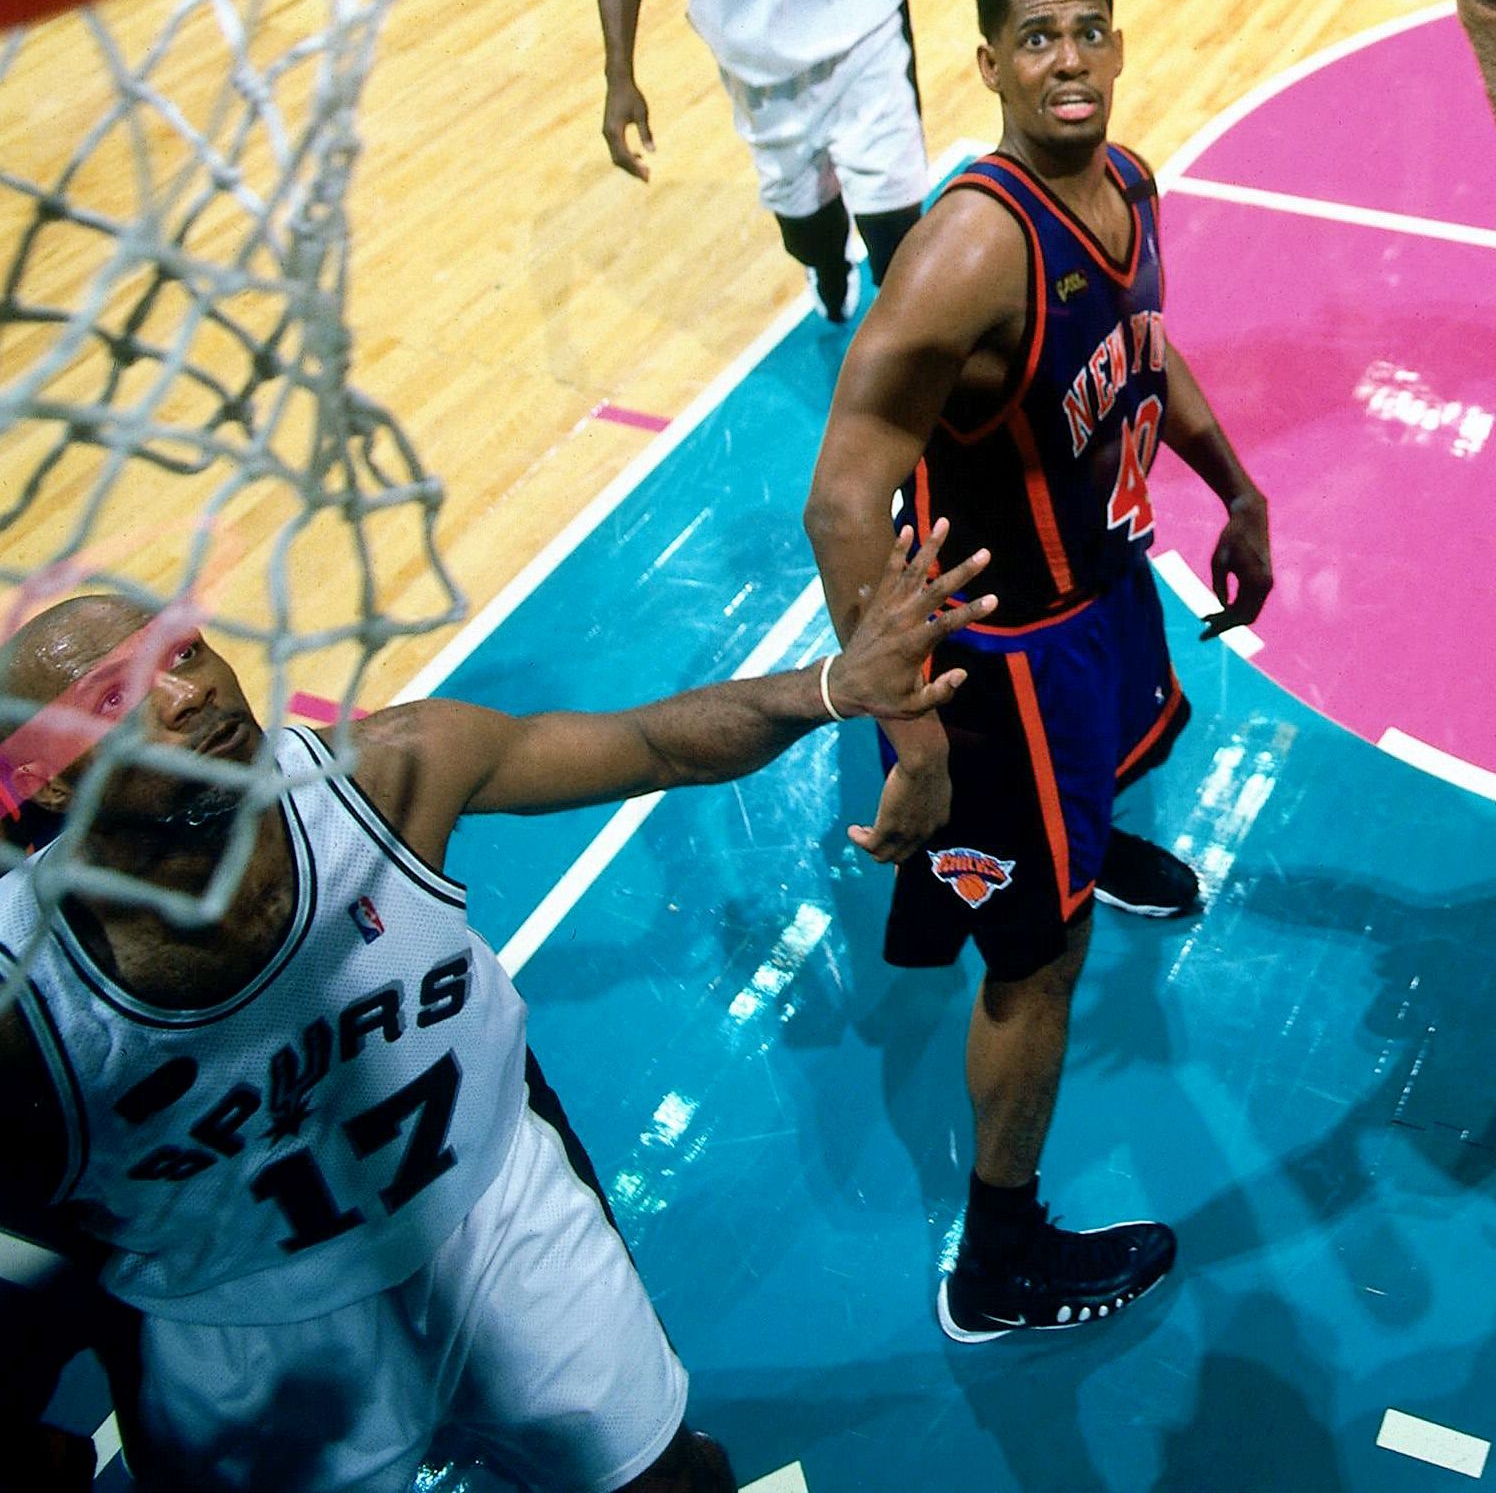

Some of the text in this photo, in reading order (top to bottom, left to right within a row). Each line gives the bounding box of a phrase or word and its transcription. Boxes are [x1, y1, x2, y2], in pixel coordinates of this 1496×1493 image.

[1063, 321, 1127, 458] NEW
[128, 948, 473, 1181] SPURS
[249, 1048, 463, 1254] 17
